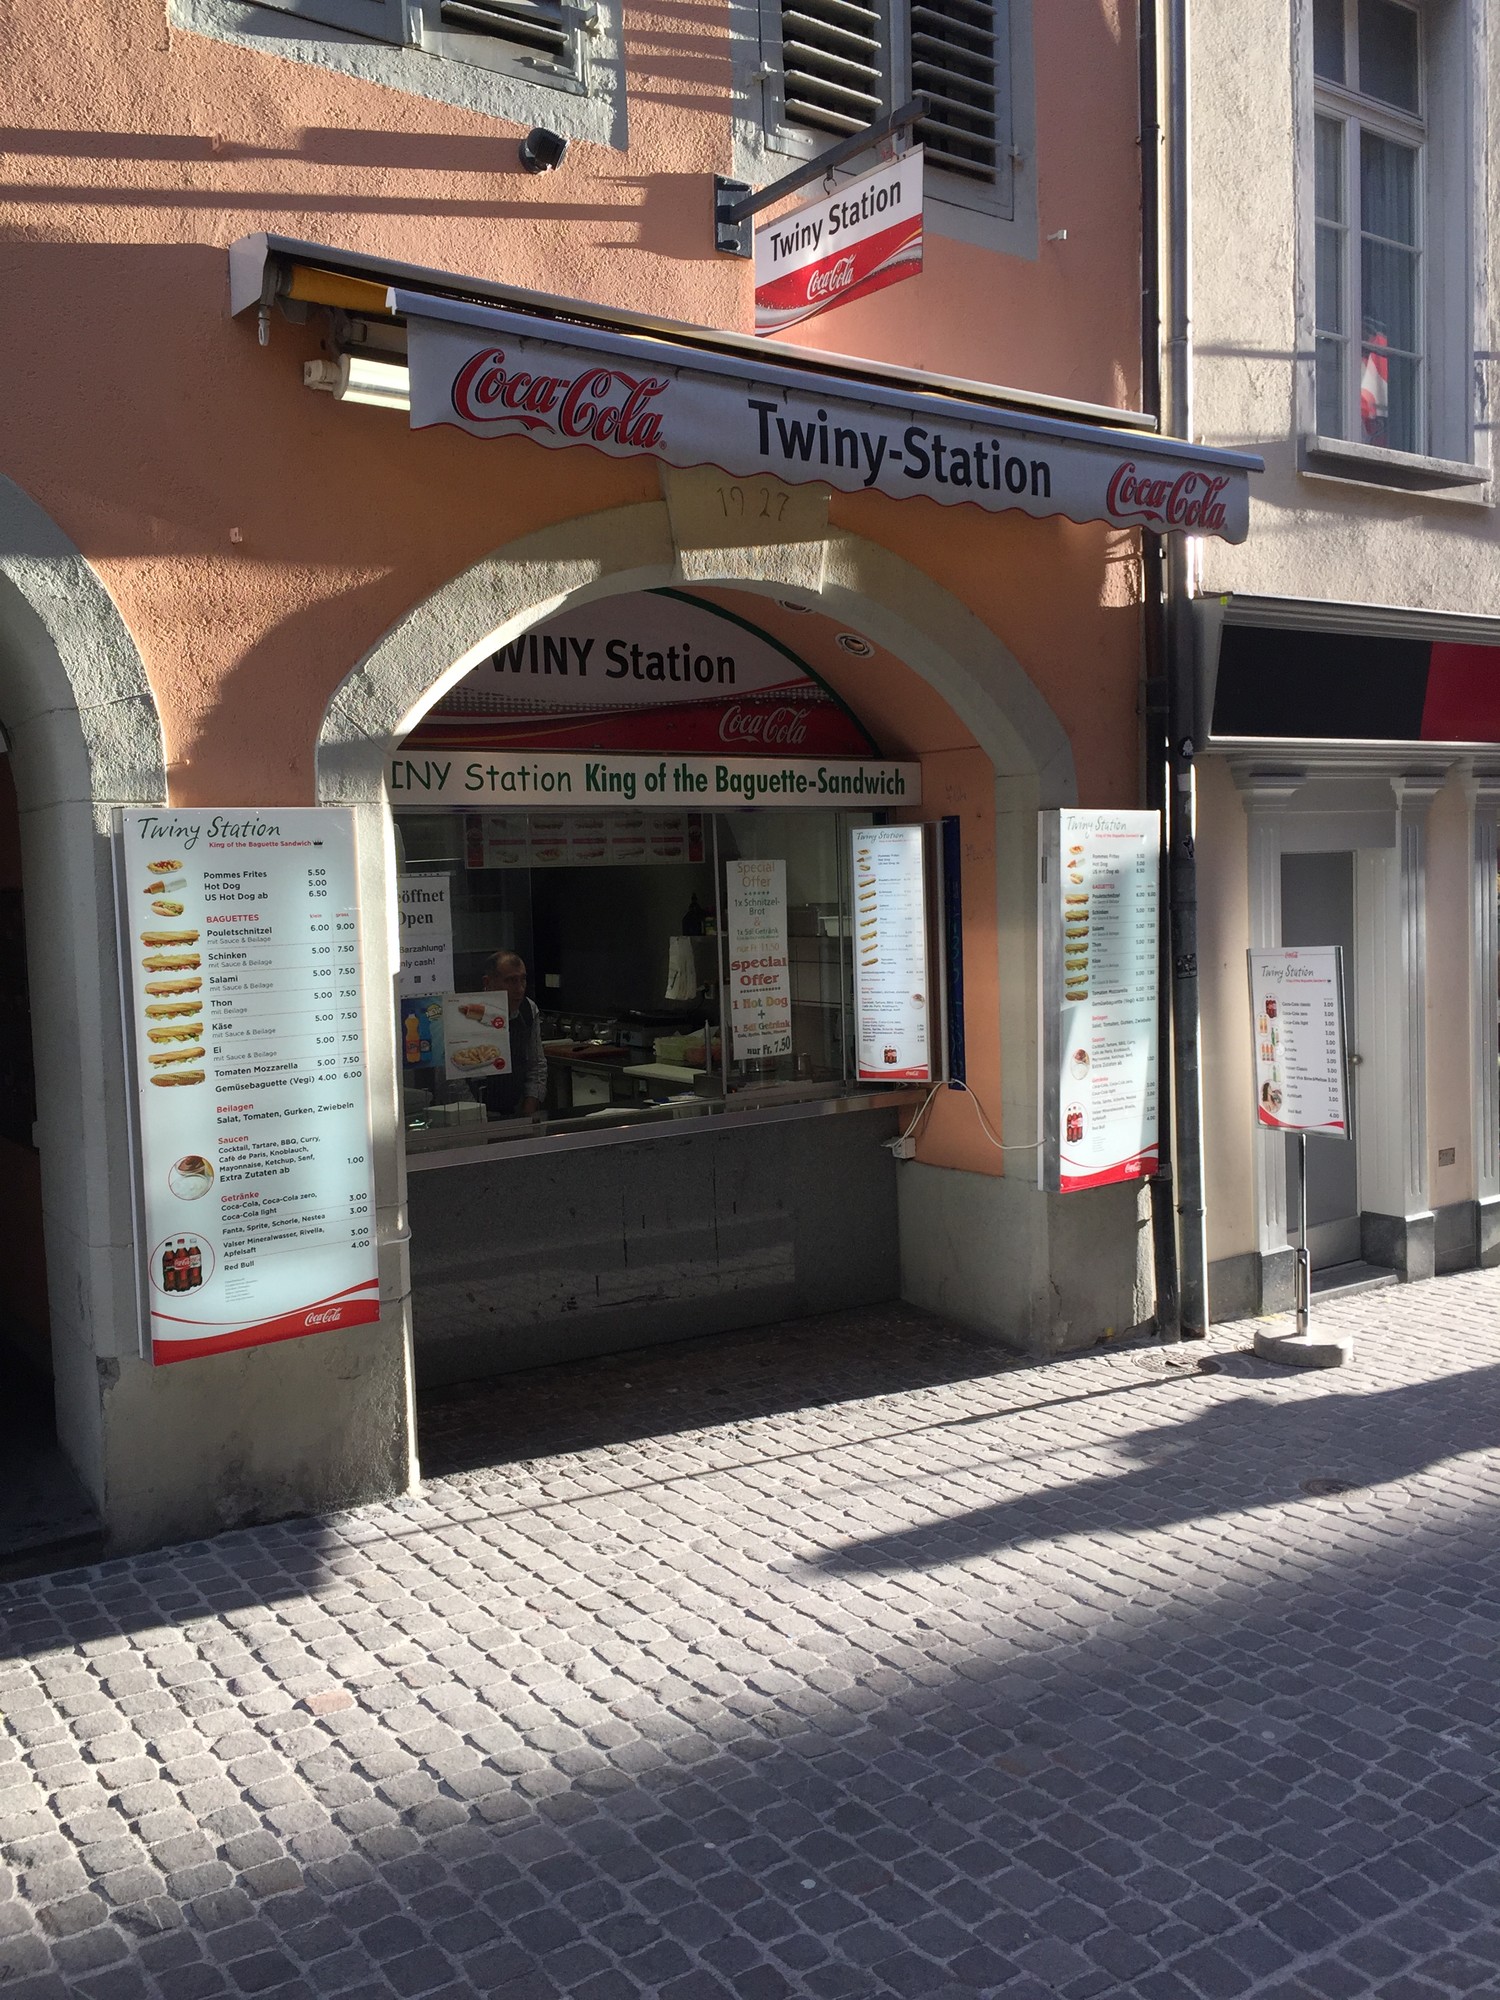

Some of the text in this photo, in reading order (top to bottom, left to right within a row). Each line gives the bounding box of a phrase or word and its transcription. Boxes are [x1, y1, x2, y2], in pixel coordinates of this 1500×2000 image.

[770, 180, 901, 262] Twiny Station
[806, 252, 857, 301] Coca-Cola
[451, 347, 1230, 532] Coca-Cola Twiny-Station Coca-Cola
[476, 634, 737, 685] WINY Station
[718, 704, 809, 746] Coca-Cola
[464, 760, 572, 793] Station
[585, 761, 637, 801] King
[644, 761, 667, 794] of
[672, 765, 709, 795] the
[715, 767, 906, 801] Baguette-Sandwich
[137, 815, 281, 850] Twiny Station
[1065, 815, 1127, 839] Twiny Station
[209, 841, 225, 849] King
[248, 840, 279, 849] Baguette
[856, 831, 904, 844] Twiny Station
[307, 868, 326, 876] 5.50
[737, 862, 775, 876] Special
[222, 882, 241, 890] Dog
[742, 874, 772, 888] Offer
[219, 893, 235, 901] Hot
[237, 892, 256, 901] Dog
[734, 896, 780, 907] 1x Schnitzel-
[206, 914, 259, 923] BAGUETTES
[749, 907, 766, 916] Brot
[207, 926, 272, 937] Pouletschnitzel
[336, 922, 355, 930] 9.00
[208, 952, 247, 961] Schinken
[414, 958, 436, 967] cash!
[209, 967, 356, 984] Salami 5.00 7.50
[739, 973, 780, 987] Offer
[1261, 964, 1314, 983] Twiny Station
[314, 991, 333, 999] 5.00
[733, 996, 788, 1010] 1 Hot Dog
[224, 1007, 248, 1015] Beilage
[212, 1022, 233, 1031] Käse
[315, 1013, 334, 1022] 5.00
[734, 1025, 739, 1033] 1
[213, 1034, 359, 1054] Ei 5.00 7.50
[746, 1035, 791, 1055] nur Fr. 7.50
[214, 1055, 360, 1077] Tomaten Mozzarella 5.00 7.50
[215, 1071, 362, 1093] Gemüsebaguette (Vegi) 4.00 6.00
[216, 1103, 254, 1114] Beilagen
[216, 1102, 354, 1125] Salat, Tomaten, Gurken, Zwiebeln
[218, 1136, 249, 1145] Saucen
[218, 1144, 251, 1154] Cocktail,
[251, 1141, 279, 1150] Tartare,
[280, 1138, 299, 1146] BBQ,
[248, 1152, 268, 1160] Paris,
[269, 1146, 309, 1157] Knoblauch,
[219, 1154, 364, 1173] Mayonnaise, Ketchup, Senf, 1.00
[219, 1166, 290, 1183] Extra Zutaten ab
[220, 1191, 259, 1203] Getränke
[221, 1192, 318, 1211] Coca-Cola, Coca-Cola zero,
[221, 1192, 367, 1221] Coca-Cola light 3.00
[222, 1205, 368, 1235] Fanta, Sprite, Schorle, Nestea 3.00
[223, 1227, 325, 1249] Valser Mineralwasser, Rivella,
[223, 1227, 369, 1257] Apfelsaft 3.00
[224, 1239, 370, 1271] Red Bull 4.00
[304, 1307, 343, 1327] Coca-Cola
